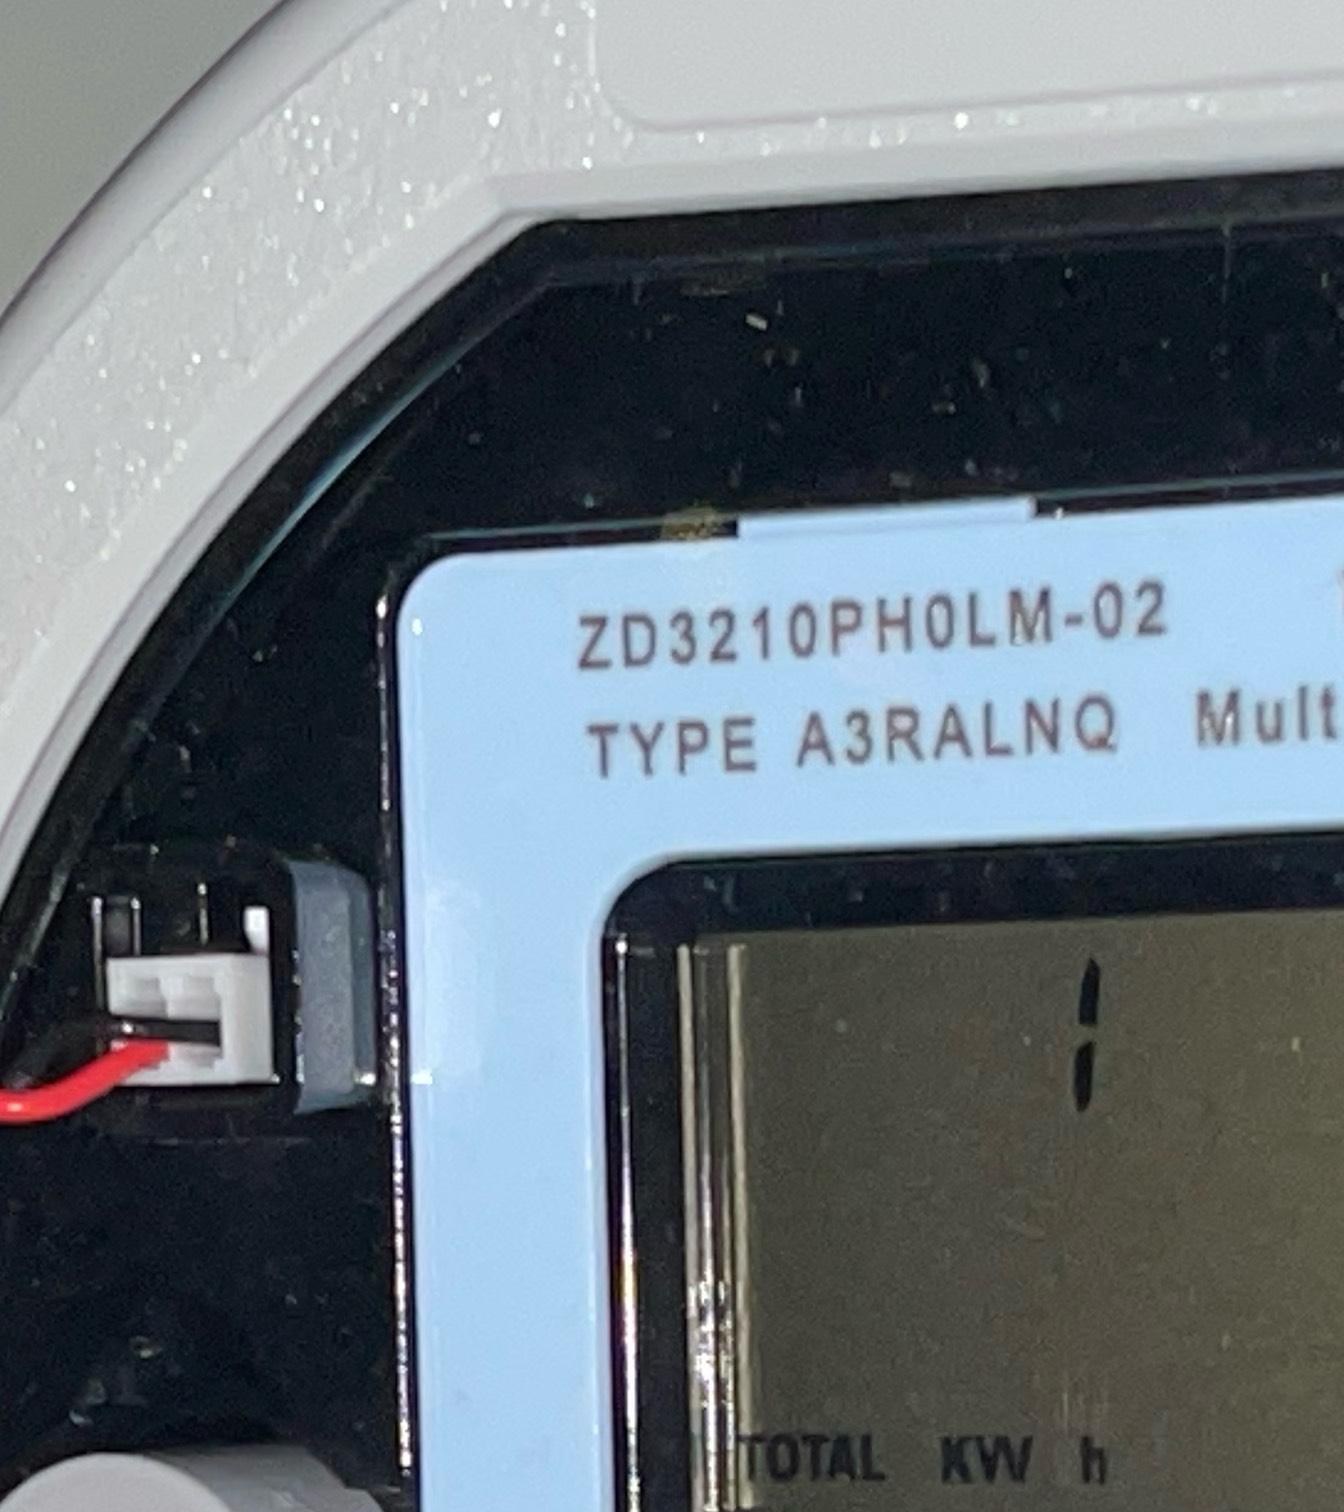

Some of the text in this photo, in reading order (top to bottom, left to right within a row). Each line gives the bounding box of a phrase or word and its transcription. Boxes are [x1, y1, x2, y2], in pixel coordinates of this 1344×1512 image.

[576, 577, 1170, 674] ZD3210PH0LM-02
[585, 692, 1119, 781] TYPE A3RALNQ
[739, 1434, 1107, 1485] TOTAL KW h
